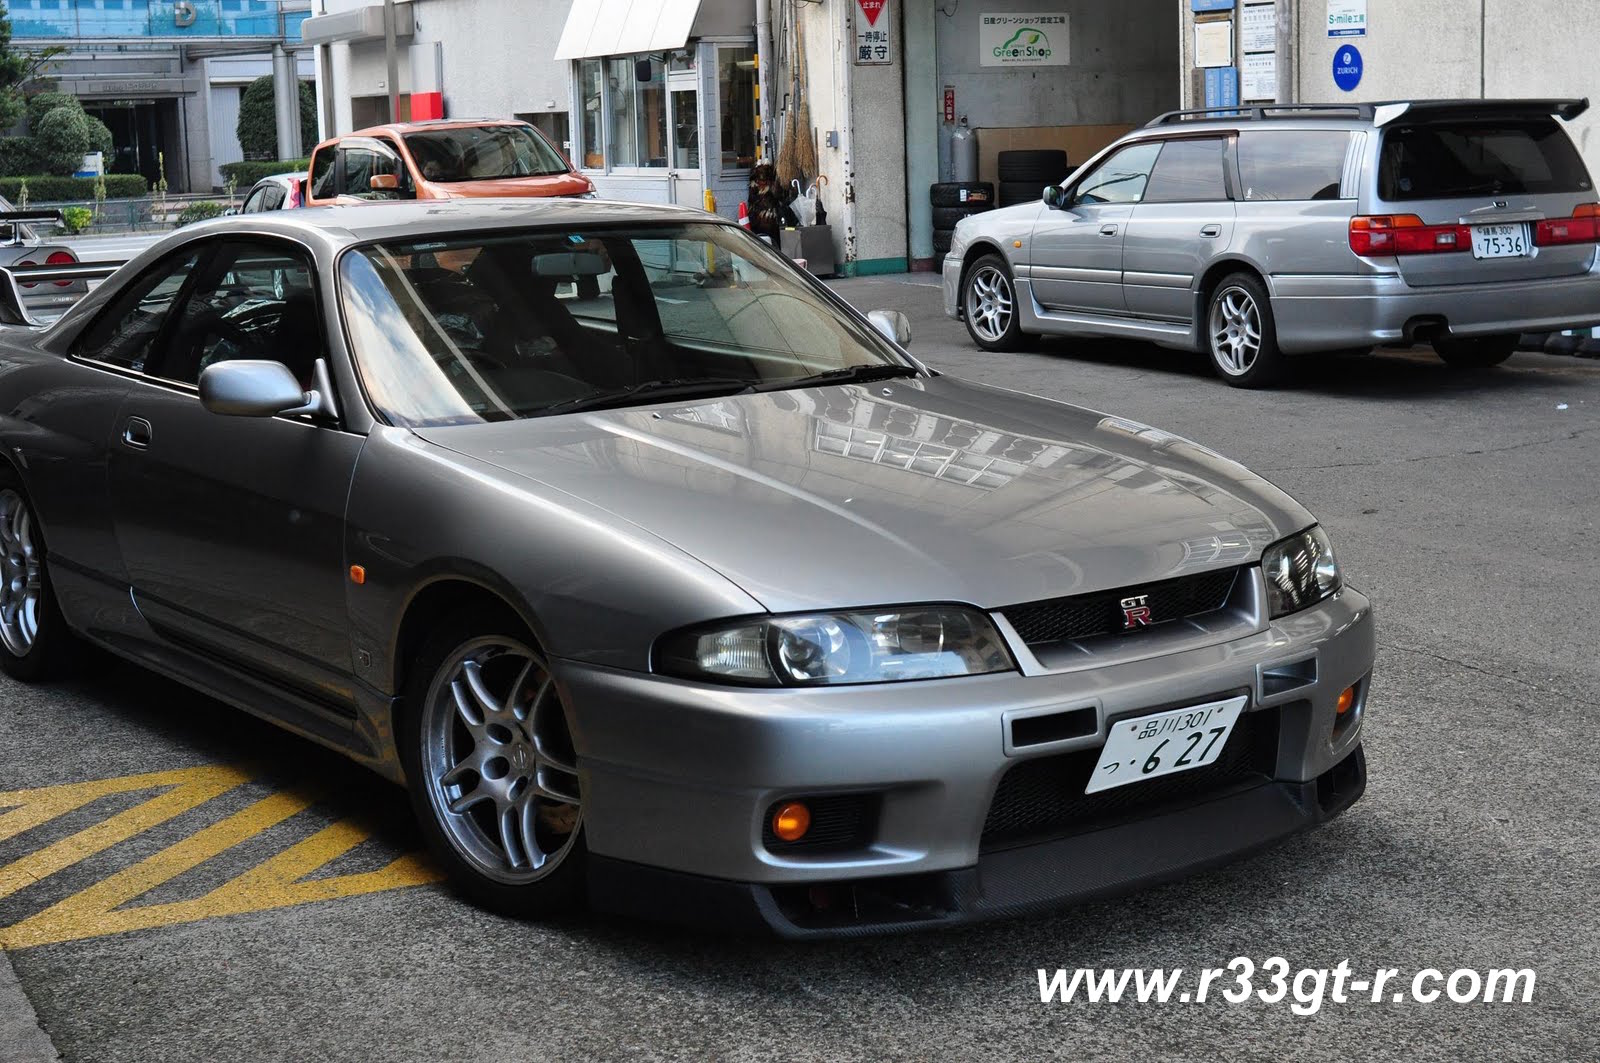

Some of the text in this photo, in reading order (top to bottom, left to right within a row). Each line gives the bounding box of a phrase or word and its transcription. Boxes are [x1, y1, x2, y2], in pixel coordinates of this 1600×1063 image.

[862, 1, 881, 9] 止まれ
[858, 31, 887, 42] 一時停止
[993, 45, 1052, 60] Green Shop
[1337, 67, 1359, 75] ZURICH
[1483, 236, 1522, 255] 75-36
